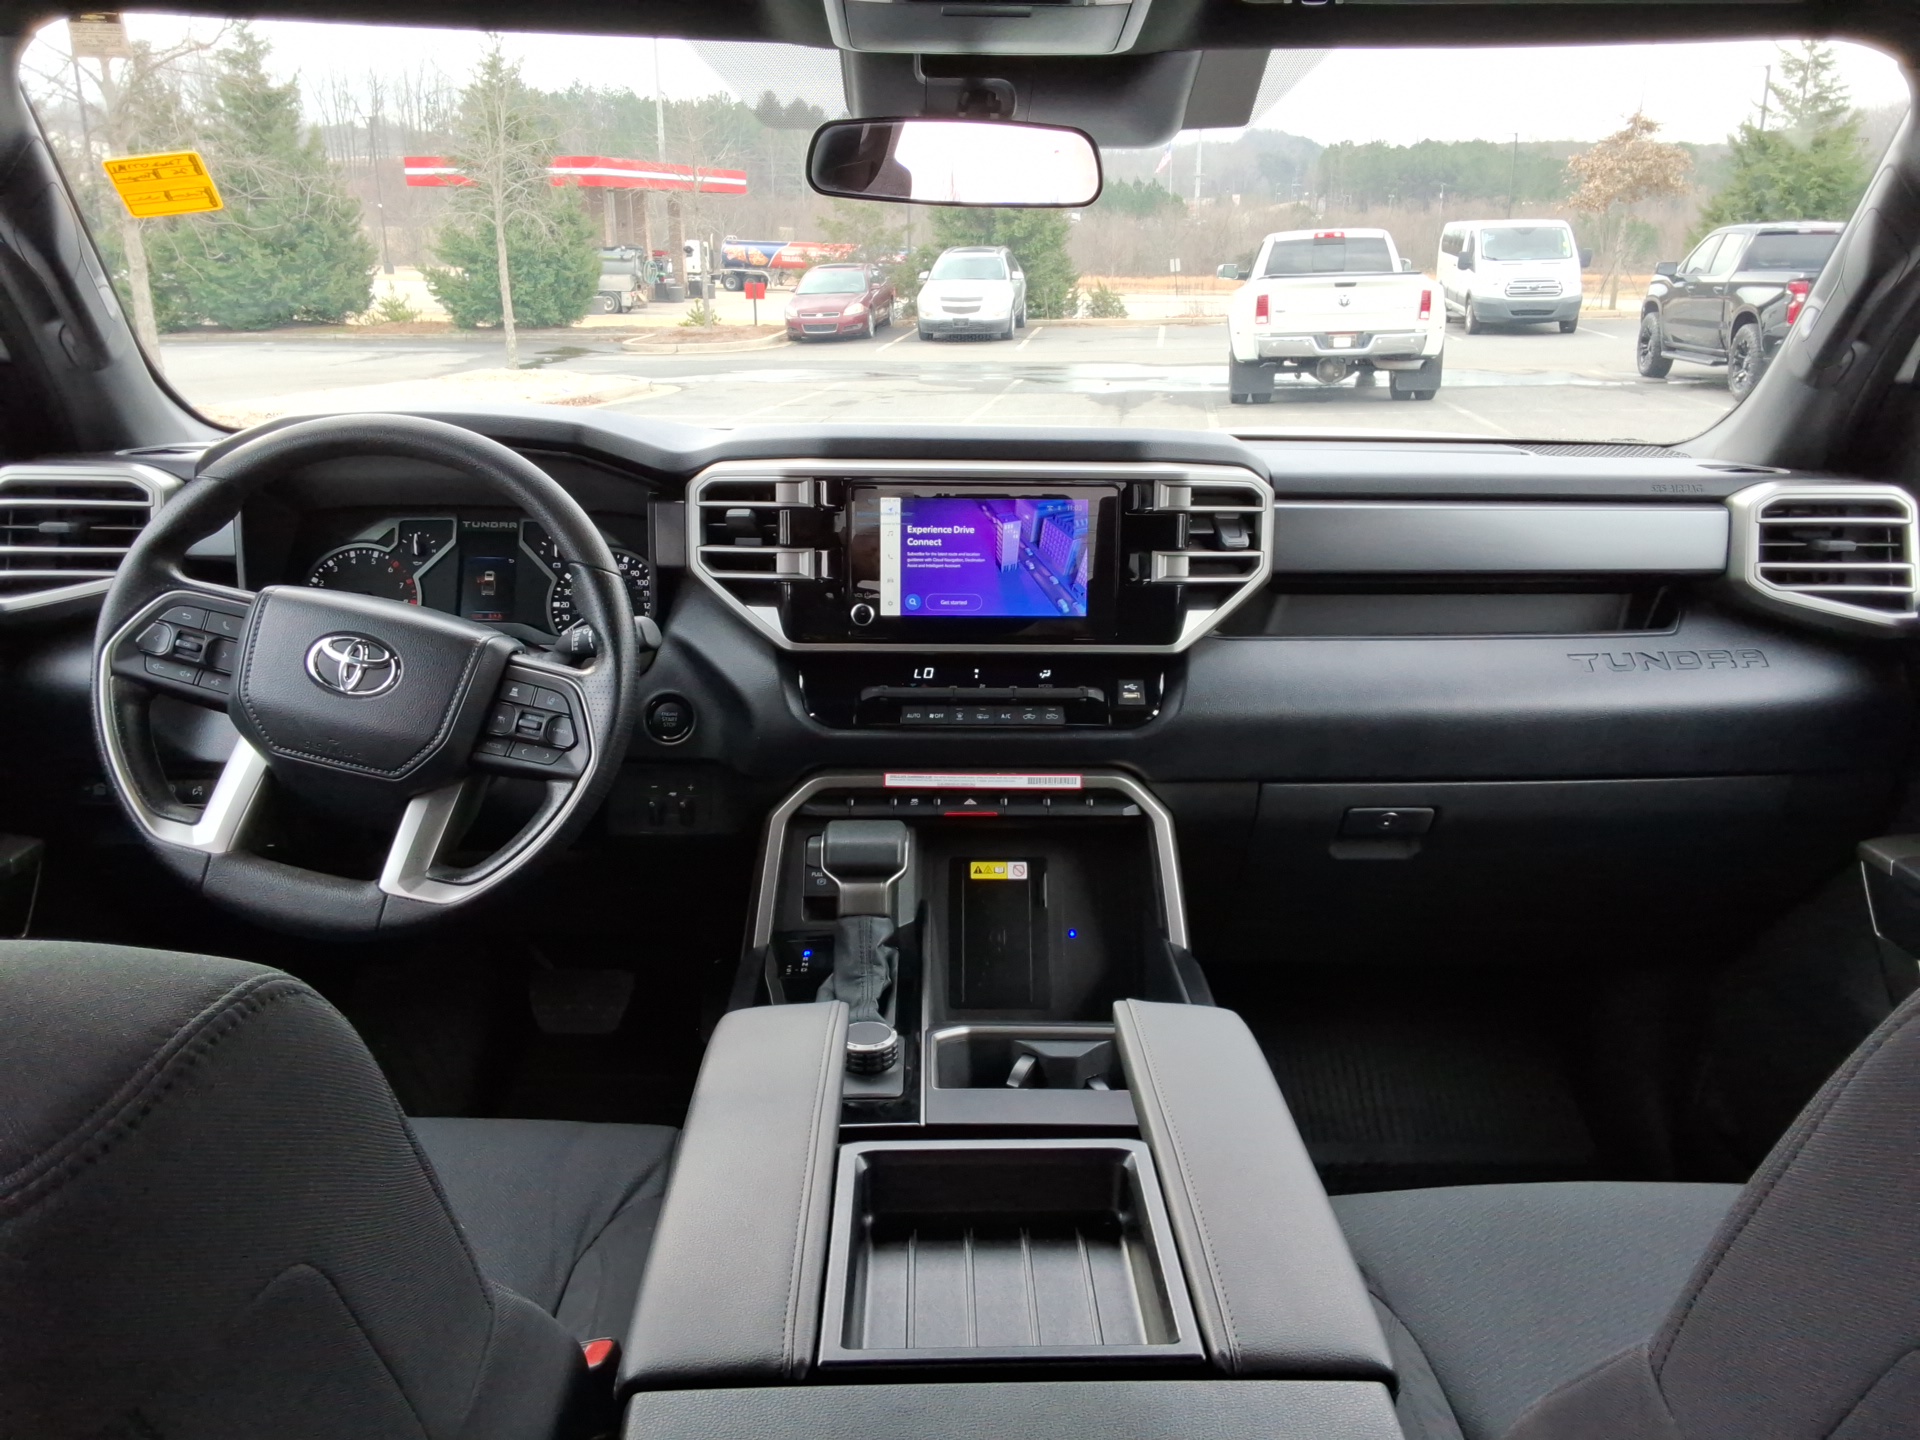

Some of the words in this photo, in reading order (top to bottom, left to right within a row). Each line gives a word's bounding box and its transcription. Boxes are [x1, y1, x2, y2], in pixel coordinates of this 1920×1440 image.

[1670, 484, 1703, 494] AIRBAG
[462, 520, 518, 529] TUNDRA
[907, 525, 952, 535] Experience
[953, 525, 975, 534] Drive
[907, 538, 942, 546] Connect
[1567, 648, 1770, 673] TUNDRA
[913, 667, 934, 679] LO
